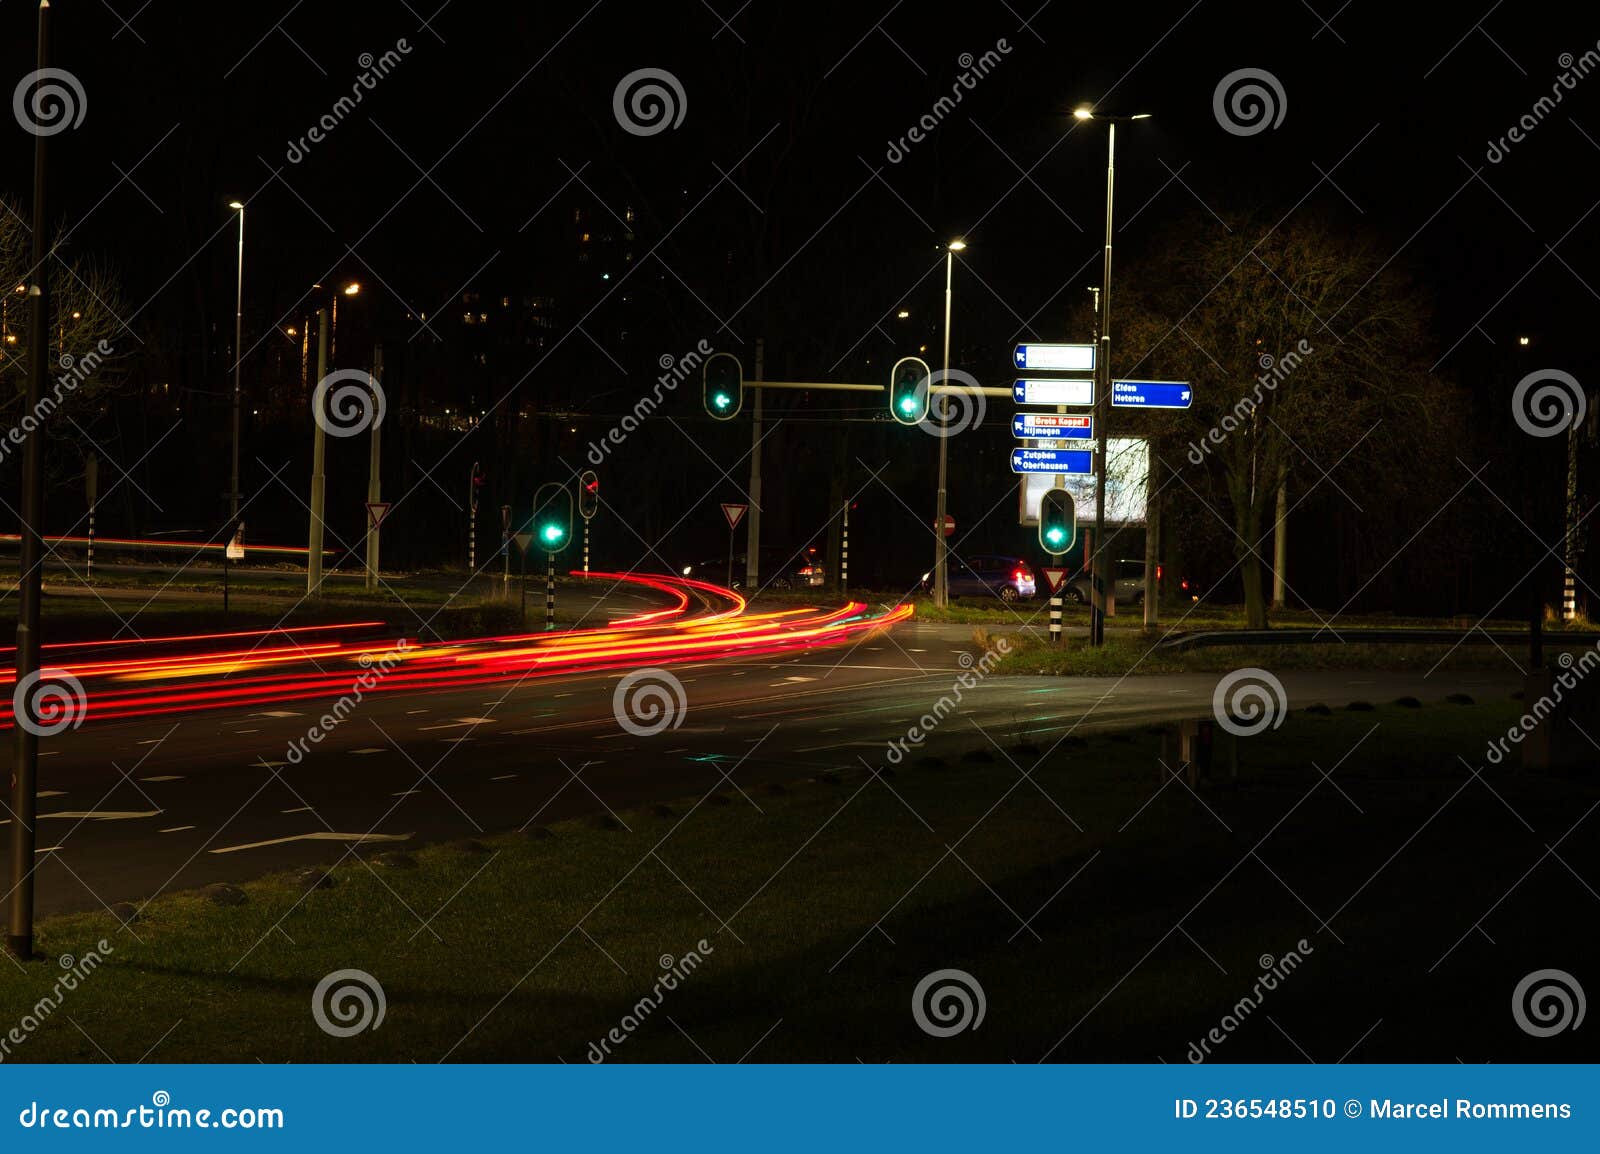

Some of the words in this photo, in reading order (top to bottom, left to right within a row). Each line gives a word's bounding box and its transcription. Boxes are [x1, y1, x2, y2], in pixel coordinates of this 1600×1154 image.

[1115, 383, 1137, 392] Elden
[1115, 394, 1145, 403] Heteren
[1035, 417, 1057, 426] Grote
[1024, 427, 1060, 437] Nijmegen
[1023, 451, 1057, 460] Zutphen
[1023, 461, 1069, 470] Oberhausen
